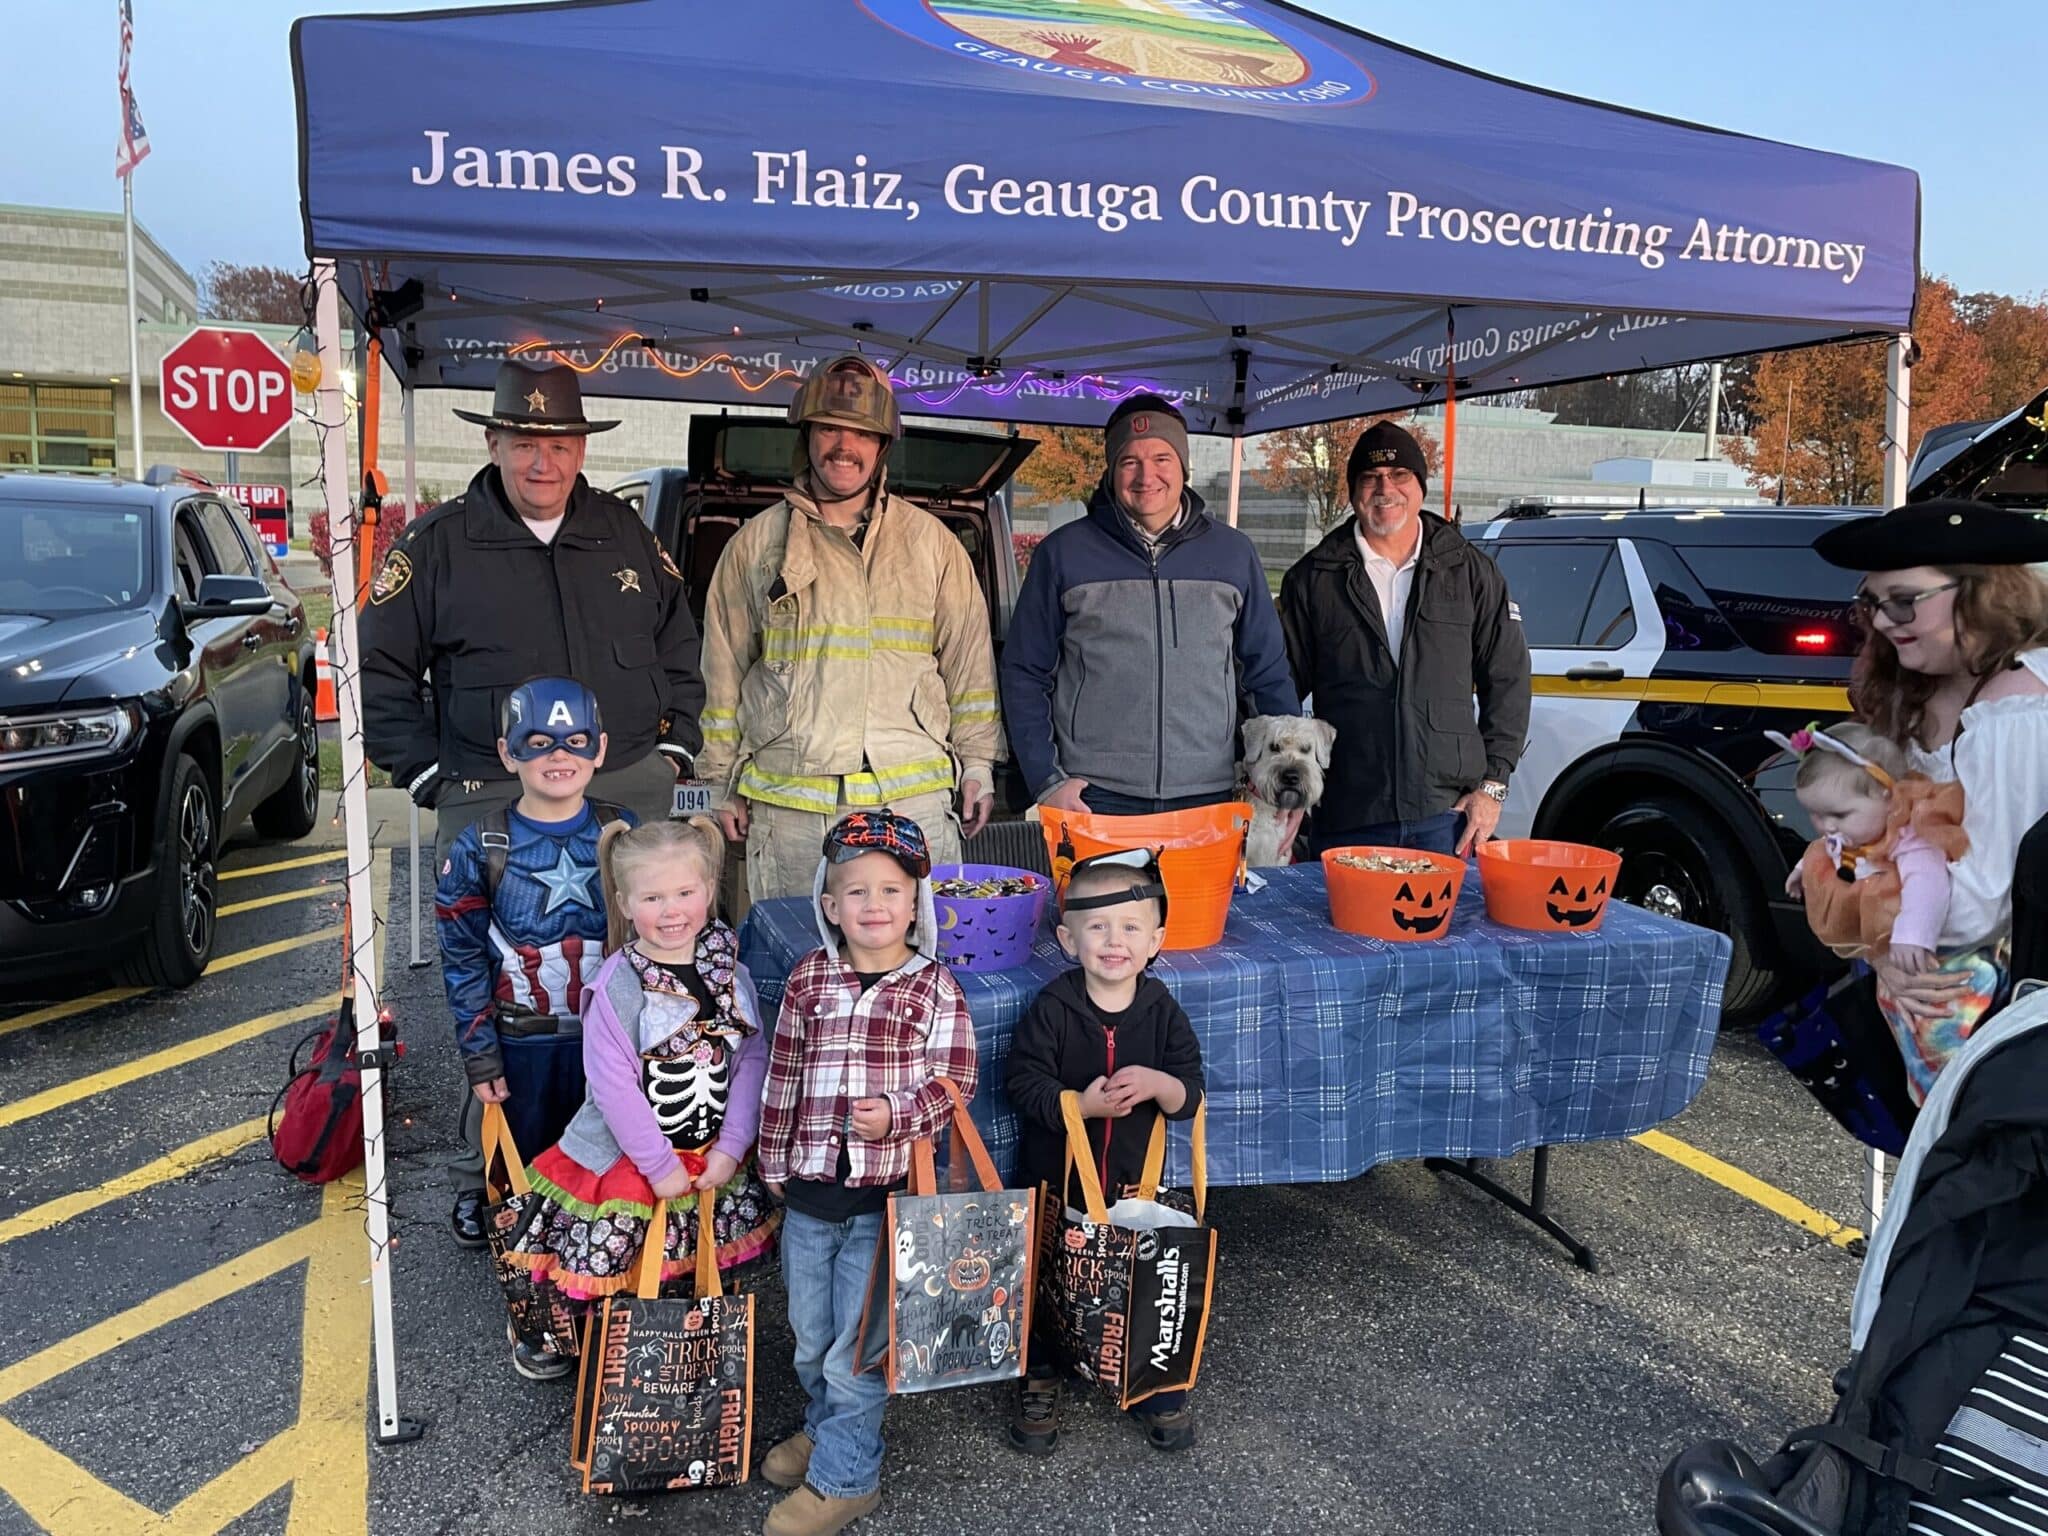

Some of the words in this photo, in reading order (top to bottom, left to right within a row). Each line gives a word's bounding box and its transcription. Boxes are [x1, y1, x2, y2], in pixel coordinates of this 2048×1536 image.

[954, 41, 1125, 86] GEAUGA
[1298, 80, 1352, 101] OHIO
[411, 130, 637, 197] James
[660, 145, 727, 201] R.
[752, 149, 920, 221] Flaiz,
[944, 163, 1162, 233] Geauga
[1180, 175, 1371, 247] County
[1385, 191, 1673, 269] Prosecuting
[1679, 217, 1866, 284] Attorney
[171, 365, 285, 414] STOP
[251, 487, 279, 504] UP!
[547, 700, 574, 726] A
[677, 790, 711, 810] 094
[967, 1215, 1006, 1229] TRICK
[987, 1227, 1022, 1242] TREAT
[1065, 1273, 1105, 1296] REAT
[1176, 1262, 1190, 1330] Marshalls.com
[1150, 1246, 1180, 1372] Marshalls
[633, 1329, 661, 1338] HAPPY
[1172, 1331, 1183, 1354] Shop
[603, 1310, 632, 1388] FRIGHT
[664, 1337, 719, 1364] TRICK
[1100, 1311, 1125, 1387] FRIGHT
[671, 1359, 719, 1381] TREAT
[643, 1381, 695, 1394] BEWARE
[605, 1402, 660, 1421] Haunted
[623, 1420, 680, 1434] SPOOKY
[718, 1388, 741, 1465] FRIGHT
